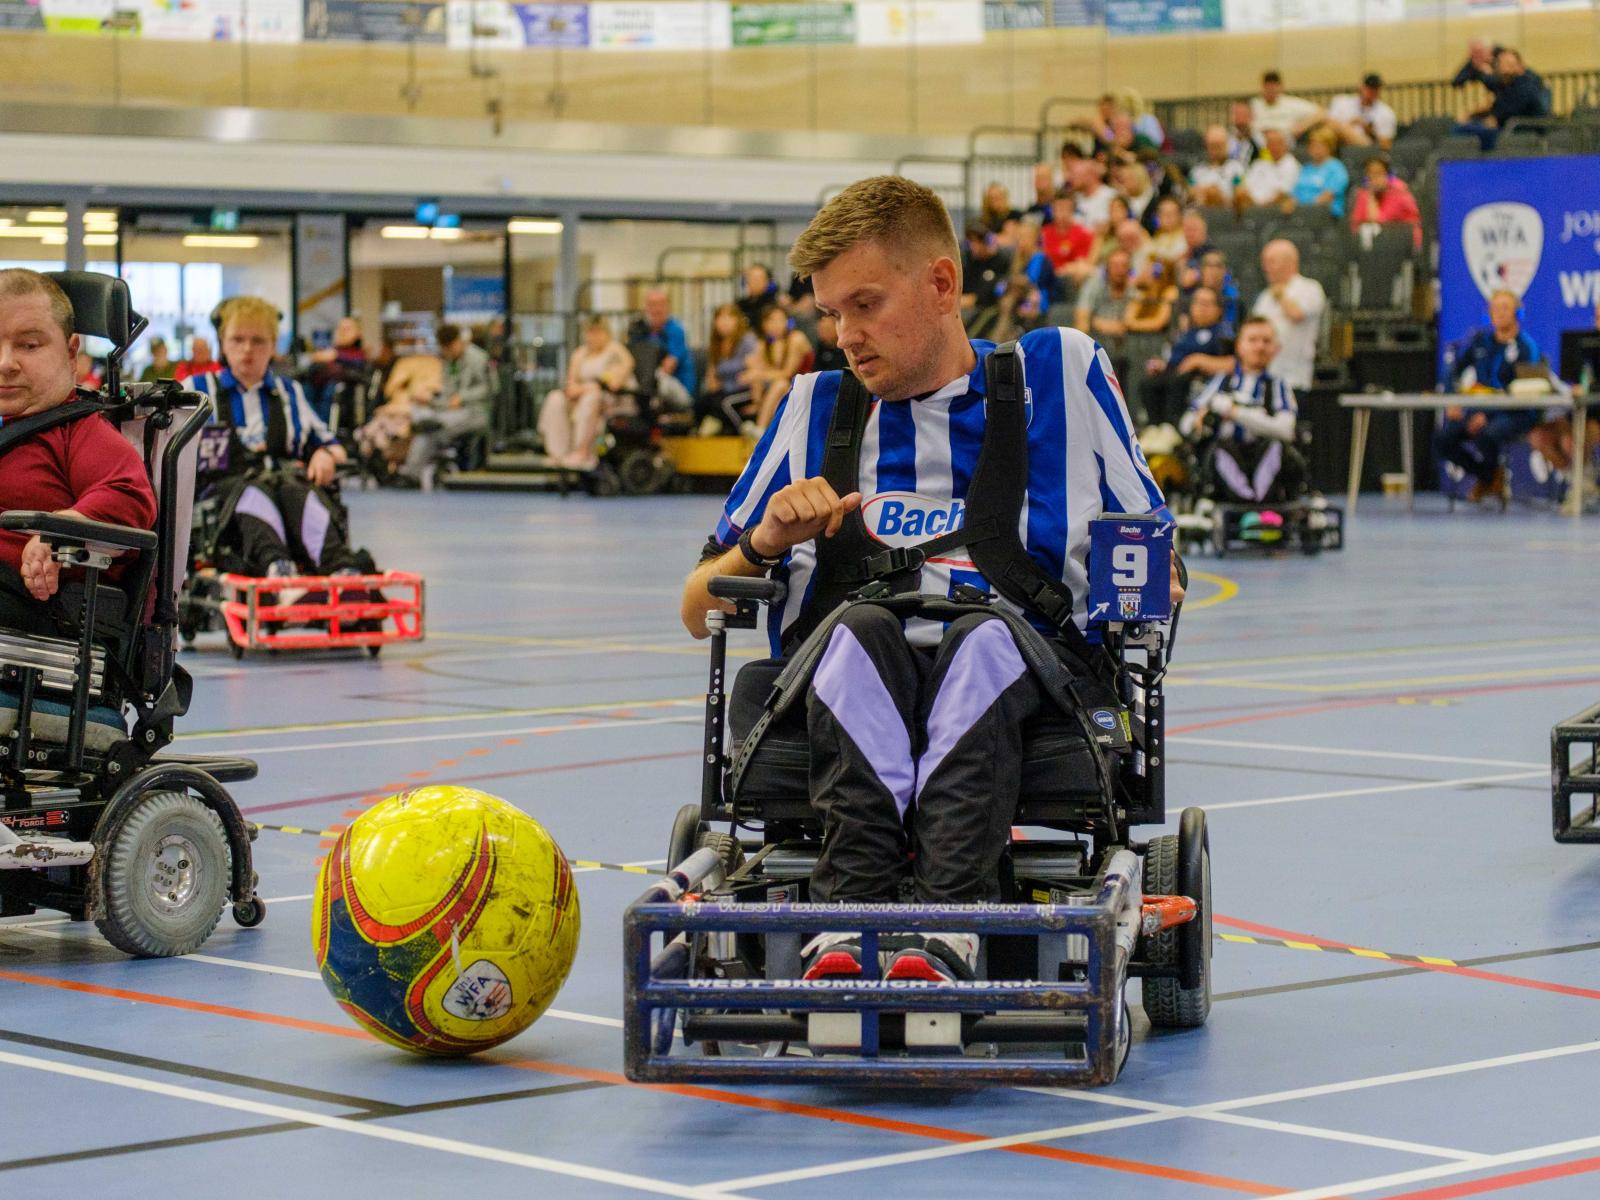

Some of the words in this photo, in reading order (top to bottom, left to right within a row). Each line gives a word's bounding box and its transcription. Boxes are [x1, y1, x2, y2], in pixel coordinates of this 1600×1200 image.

[1112, 545, 1148, 587] 9
[718, 902, 782, 913] WEST
[455, 976, 490, 1006] WFA
[687, 979, 766, 989] WEST
